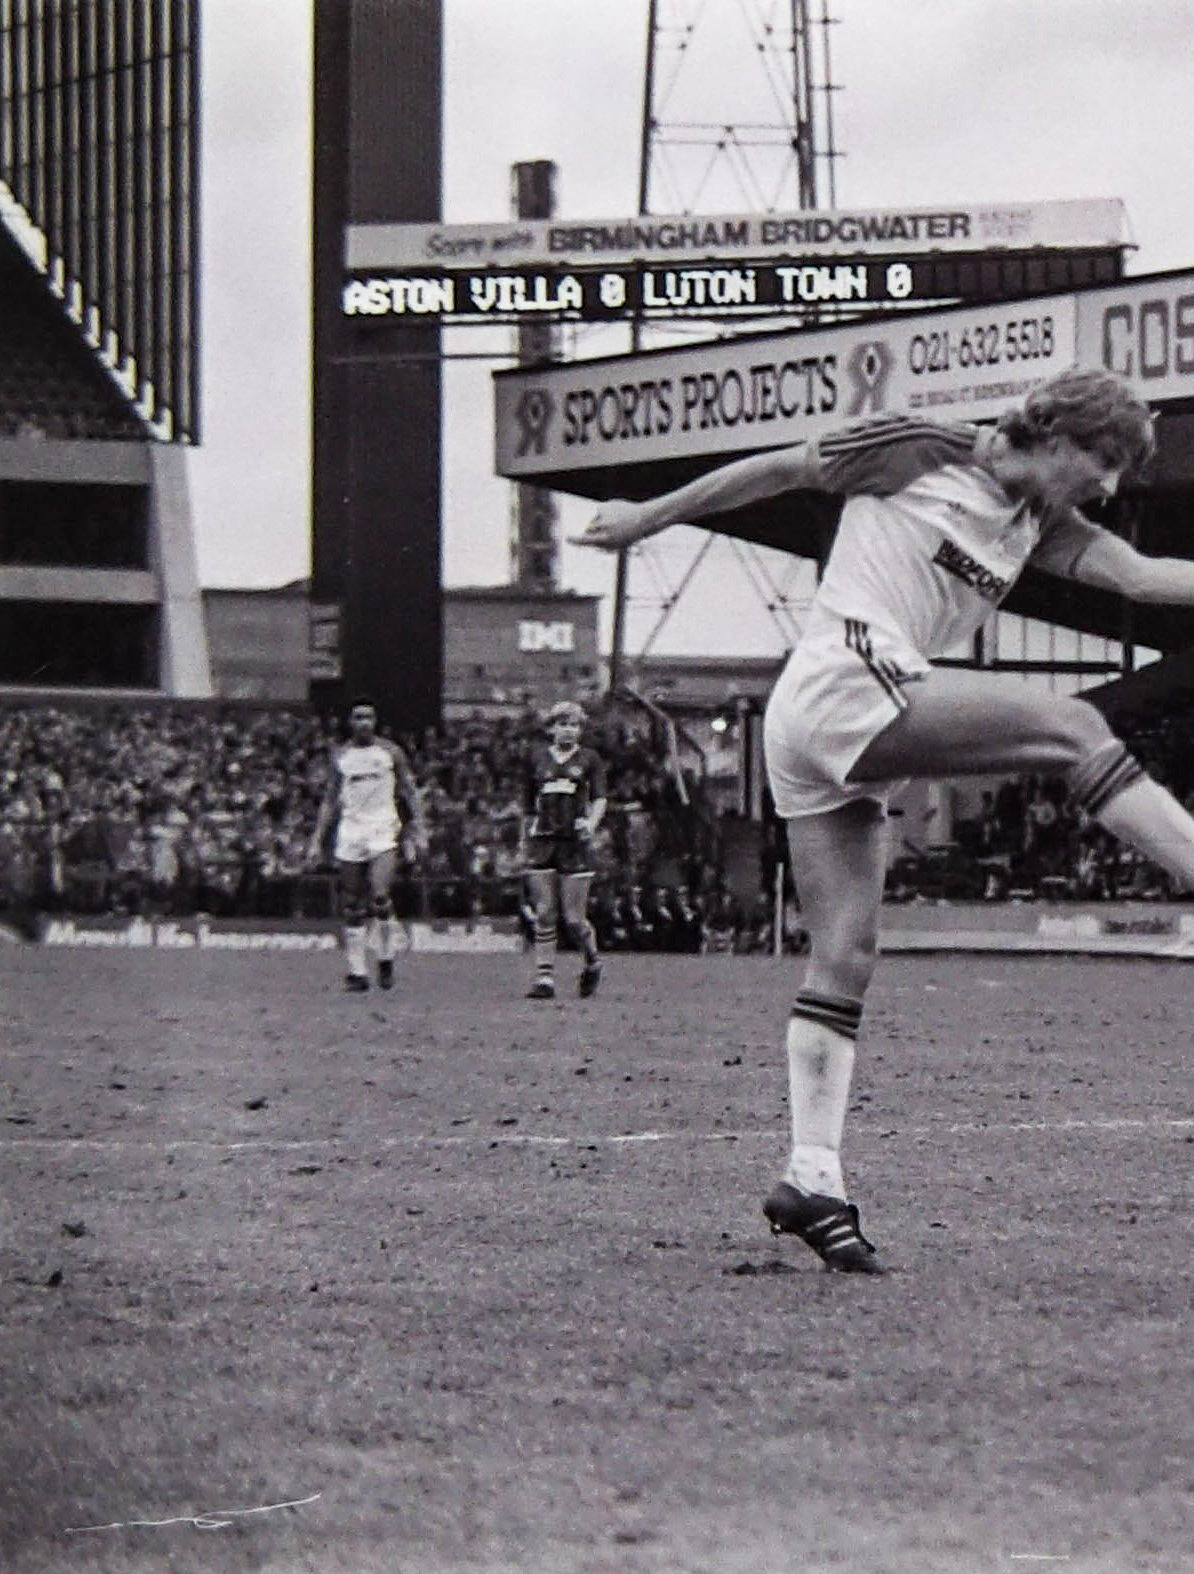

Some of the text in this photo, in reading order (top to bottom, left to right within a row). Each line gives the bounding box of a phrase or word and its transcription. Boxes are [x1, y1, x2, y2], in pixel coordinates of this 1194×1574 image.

[547, 218, 749, 253] BIRMINGHAM
[761, 212, 971, 245] BRIDGWATER
[344, 277, 454, 315] ASTON
[471, 273, 583, 310] VILLA
[644, 269, 757, 305] LUTON
[777, 264, 868, 301] TOWN
[886, 262, 913, 299] 0
[563, 380, 673, 445] SPORTS
[681, 355, 837, 431] PROJECTS
